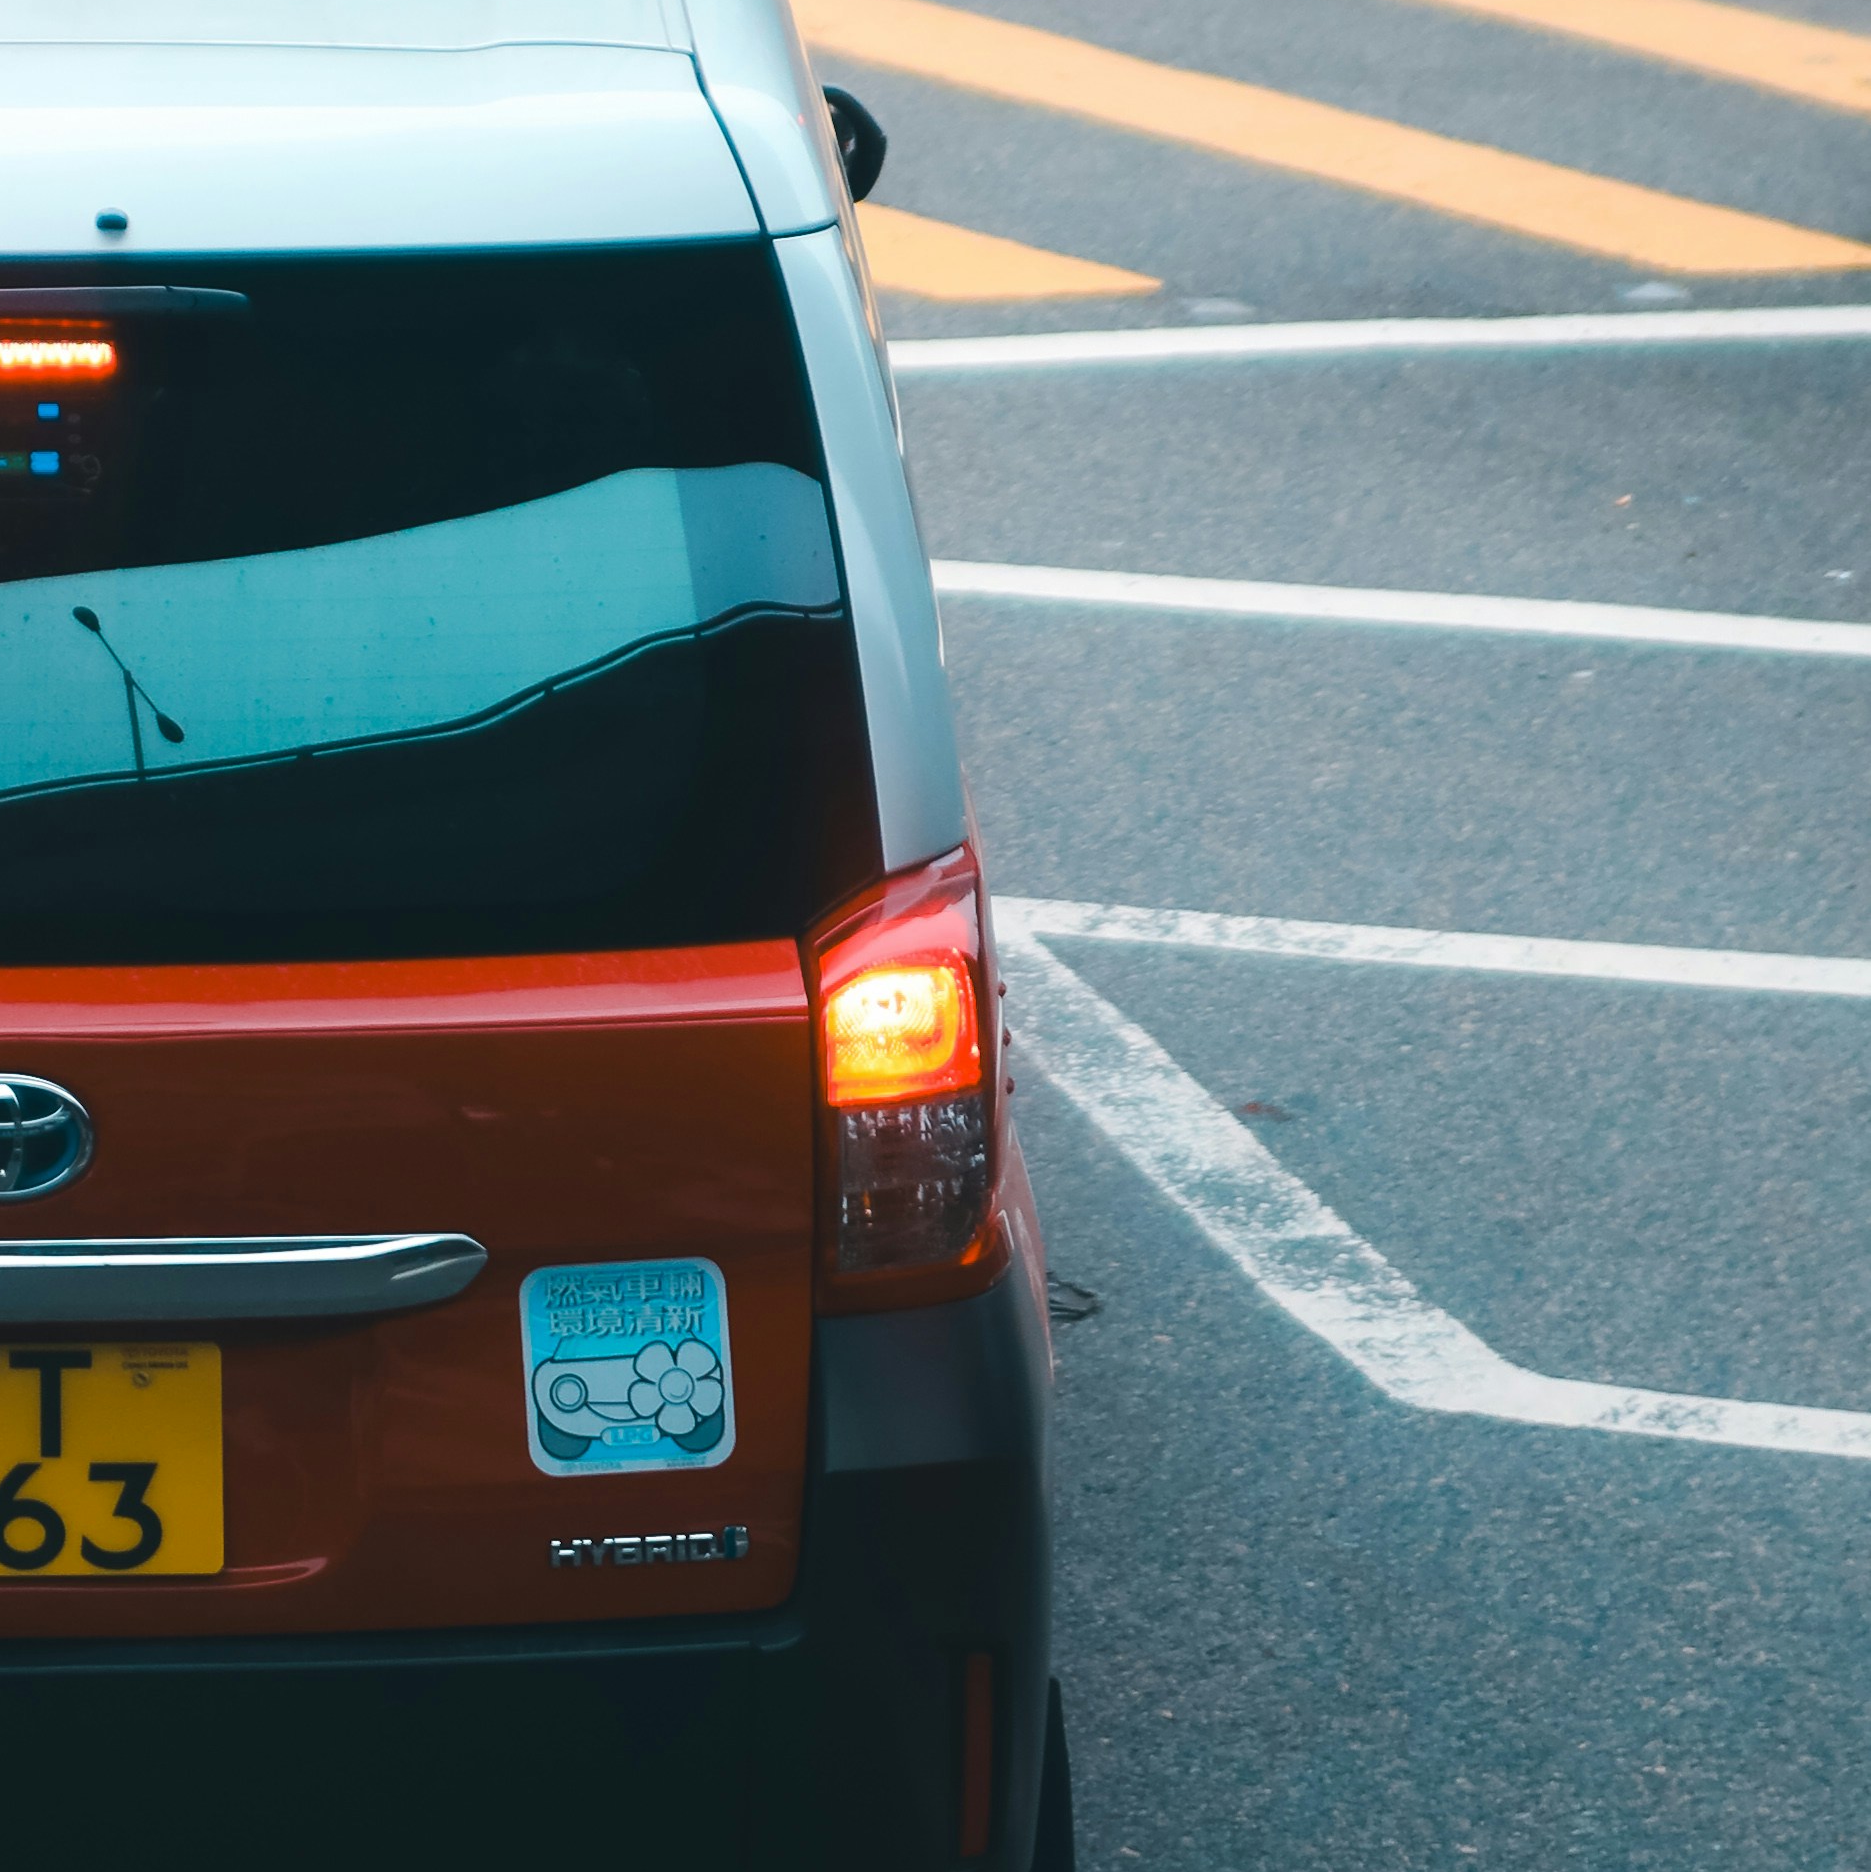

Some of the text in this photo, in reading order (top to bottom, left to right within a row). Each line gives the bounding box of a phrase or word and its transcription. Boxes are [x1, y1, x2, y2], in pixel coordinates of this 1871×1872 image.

[546, 1269, 705, 1307] 燃氣車輛
[549, 1303, 704, 1337] 環境清新
[611, 1426, 653, 1444] LPG
[550, 1533, 718, 1568] HYBRID
